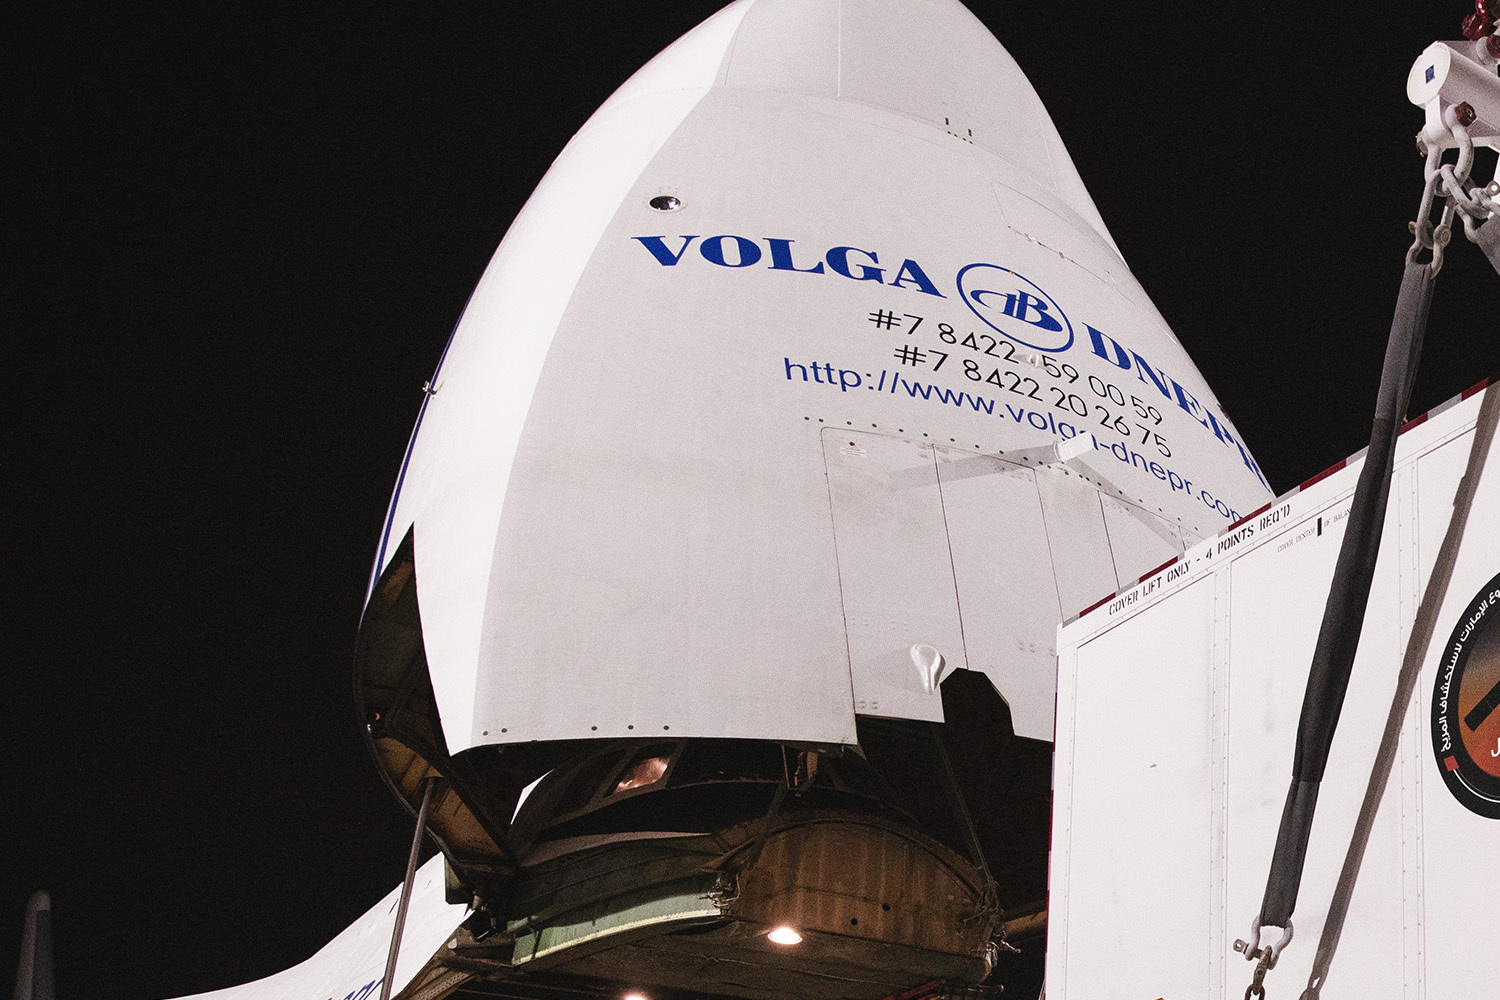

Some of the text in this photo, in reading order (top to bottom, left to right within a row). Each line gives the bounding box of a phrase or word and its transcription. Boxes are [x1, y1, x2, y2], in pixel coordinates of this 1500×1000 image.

[632, 235, 1271, 493] VOLGA DNEPR
[868, 308, 1163, 427] #7 8422 59 00 59
[893, 344, 1173, 458] #7 8422 20 26 75
[783, 356, 1243, 523] http://www.volg-dnepr.co
[1109, 590, 1138, 616] COVER
[1143, 577, 1162, 598] LIFT
[1167, 561, 1191, 583] ONLY
[1206, 547, 1212, 560] 4
[1217, 525, 1254, 555] POINTS
[1259, 503, 1291, 531] REQ'D
